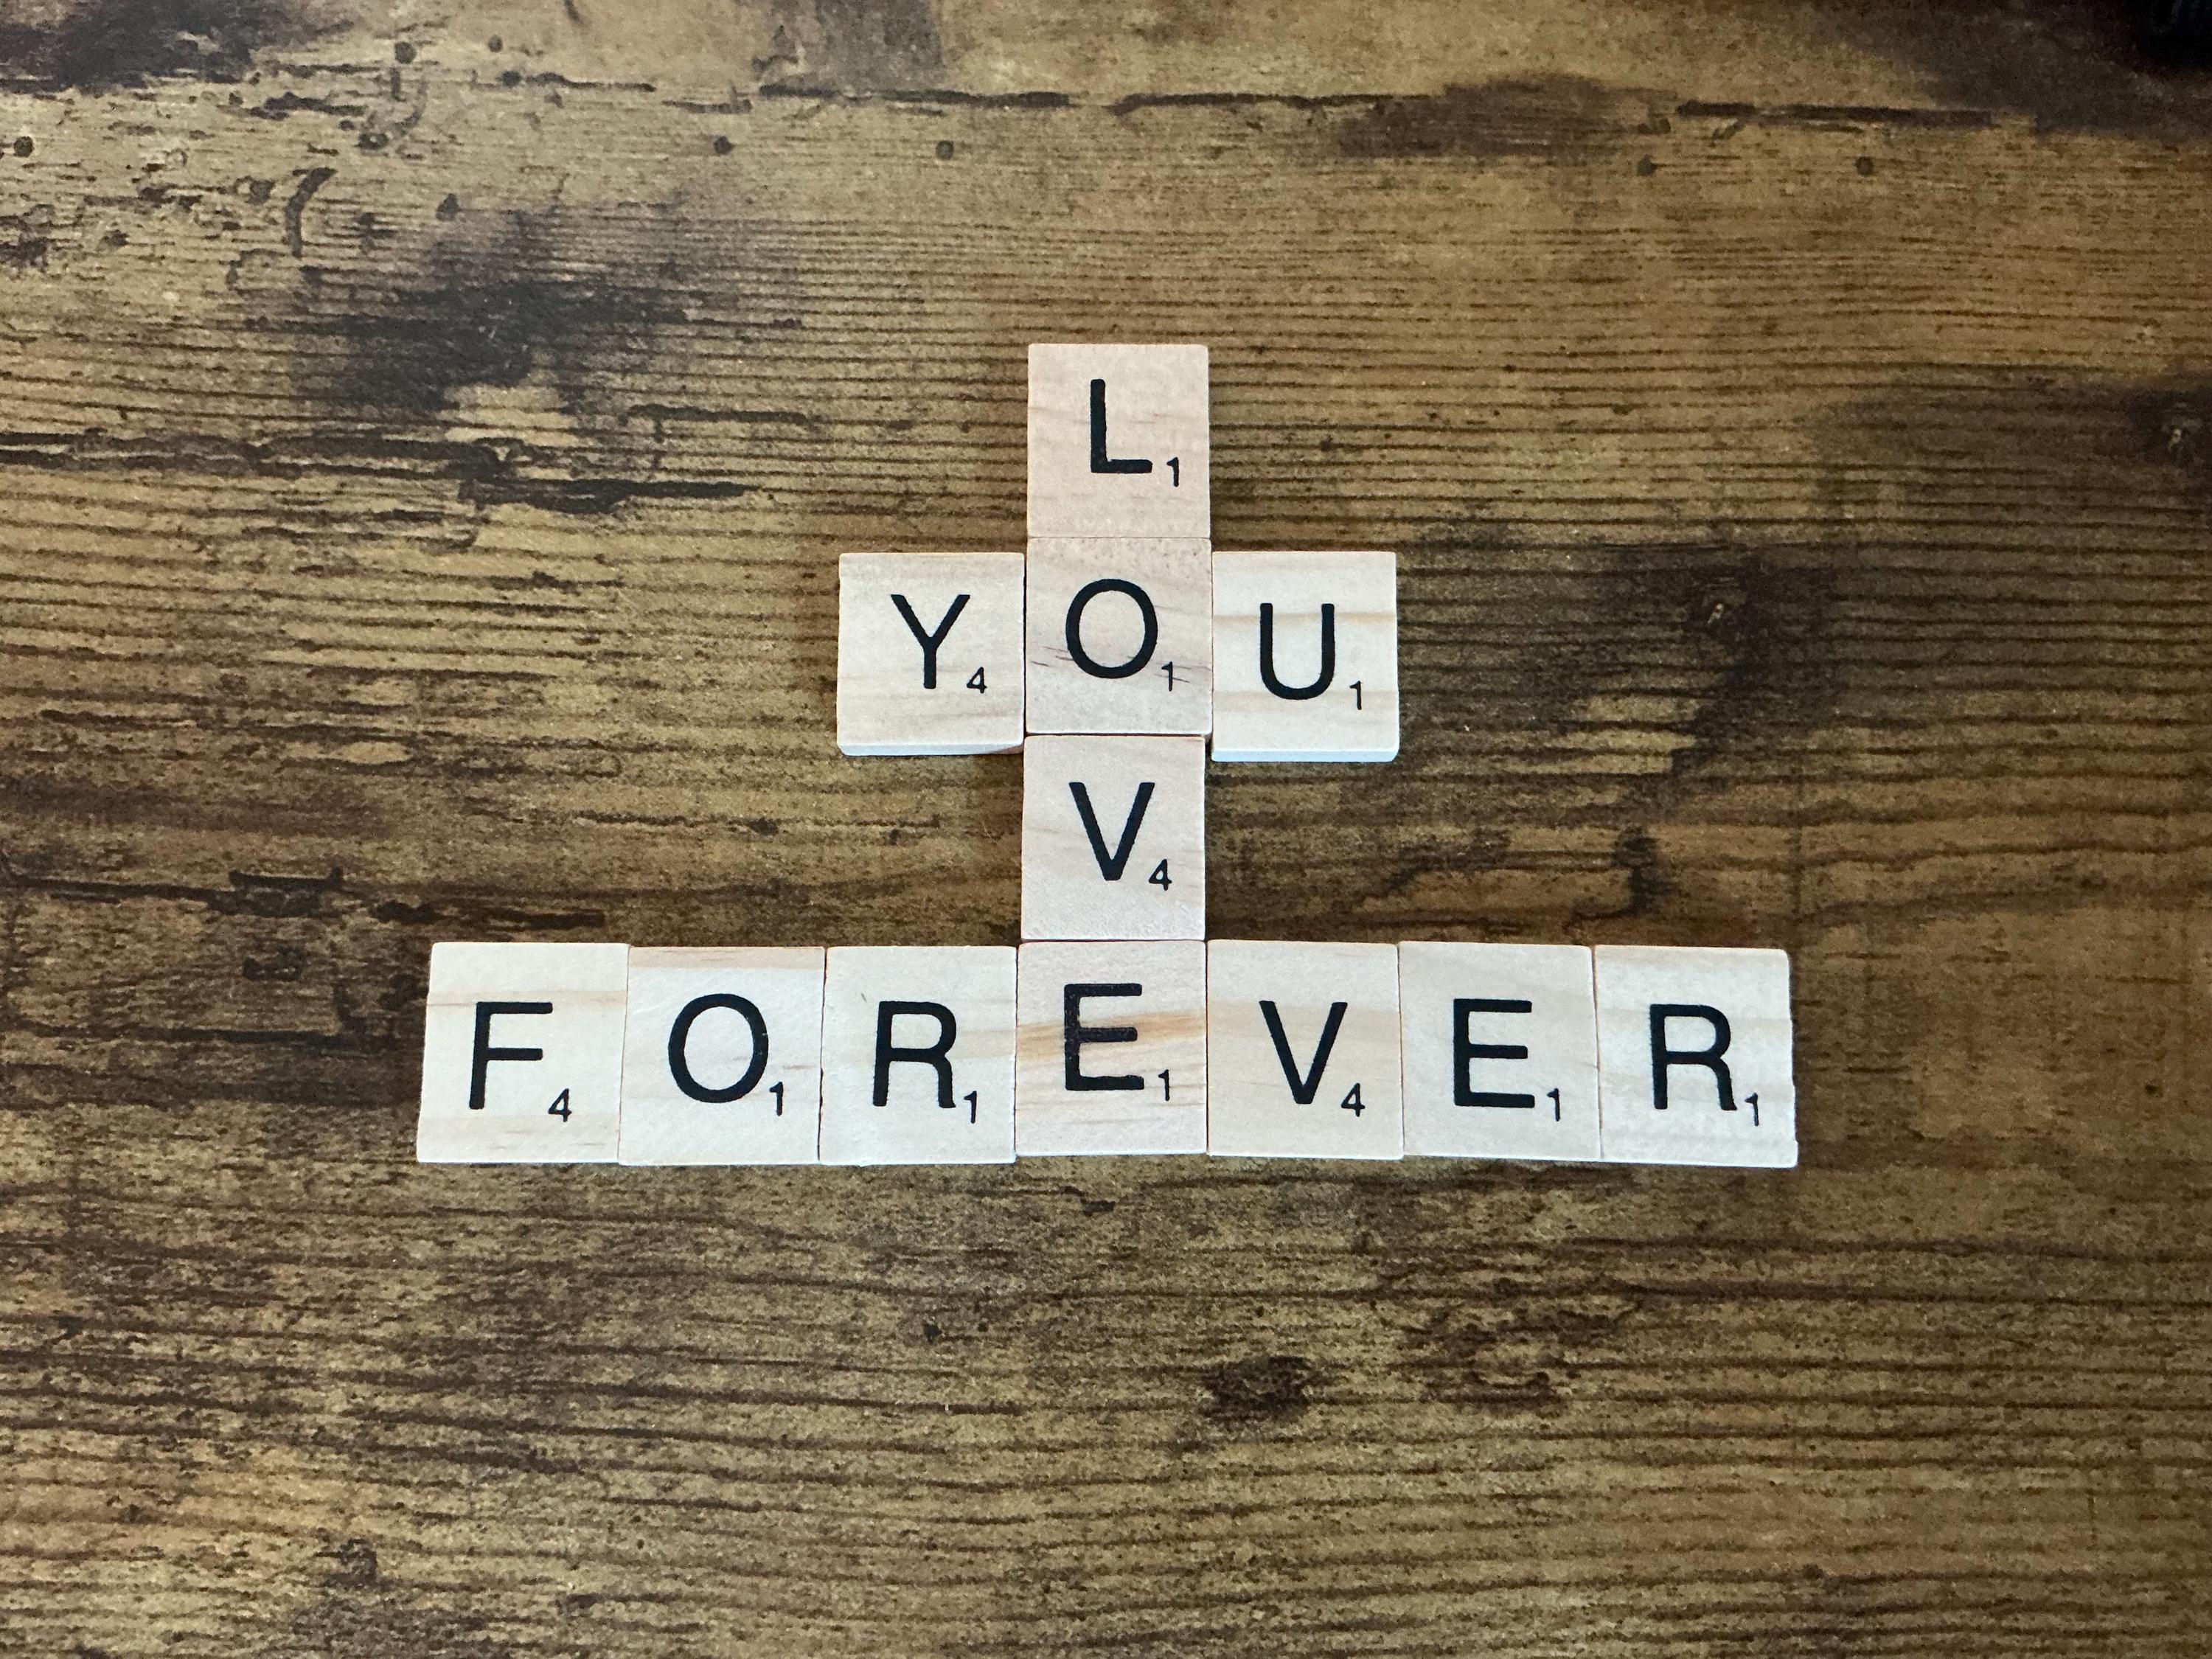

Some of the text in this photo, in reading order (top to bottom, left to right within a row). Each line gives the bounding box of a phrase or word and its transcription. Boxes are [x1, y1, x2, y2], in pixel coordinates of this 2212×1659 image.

[1166, 456, 1180, 487] 1
[966, 667, 987, 694] 4
[1161, 661, 1175, 692] 1
[1349, 681, 1362, 711] 1
[1148, 858, 1172, 891] 4
[467, 983, 1739, 1111] FOREVER
[769, 1081, 784, 1117] 1
[1158, 1068, 1170, 1102] 1
[1340, 1082, 1366, 1118] 4
[548, 1088, 572, 1123] 4
[964, 1091, 978, 1124] 1
[1547, 1088, 1561, 1122] 1
[1745, 1093, 1759, 1127] 1
